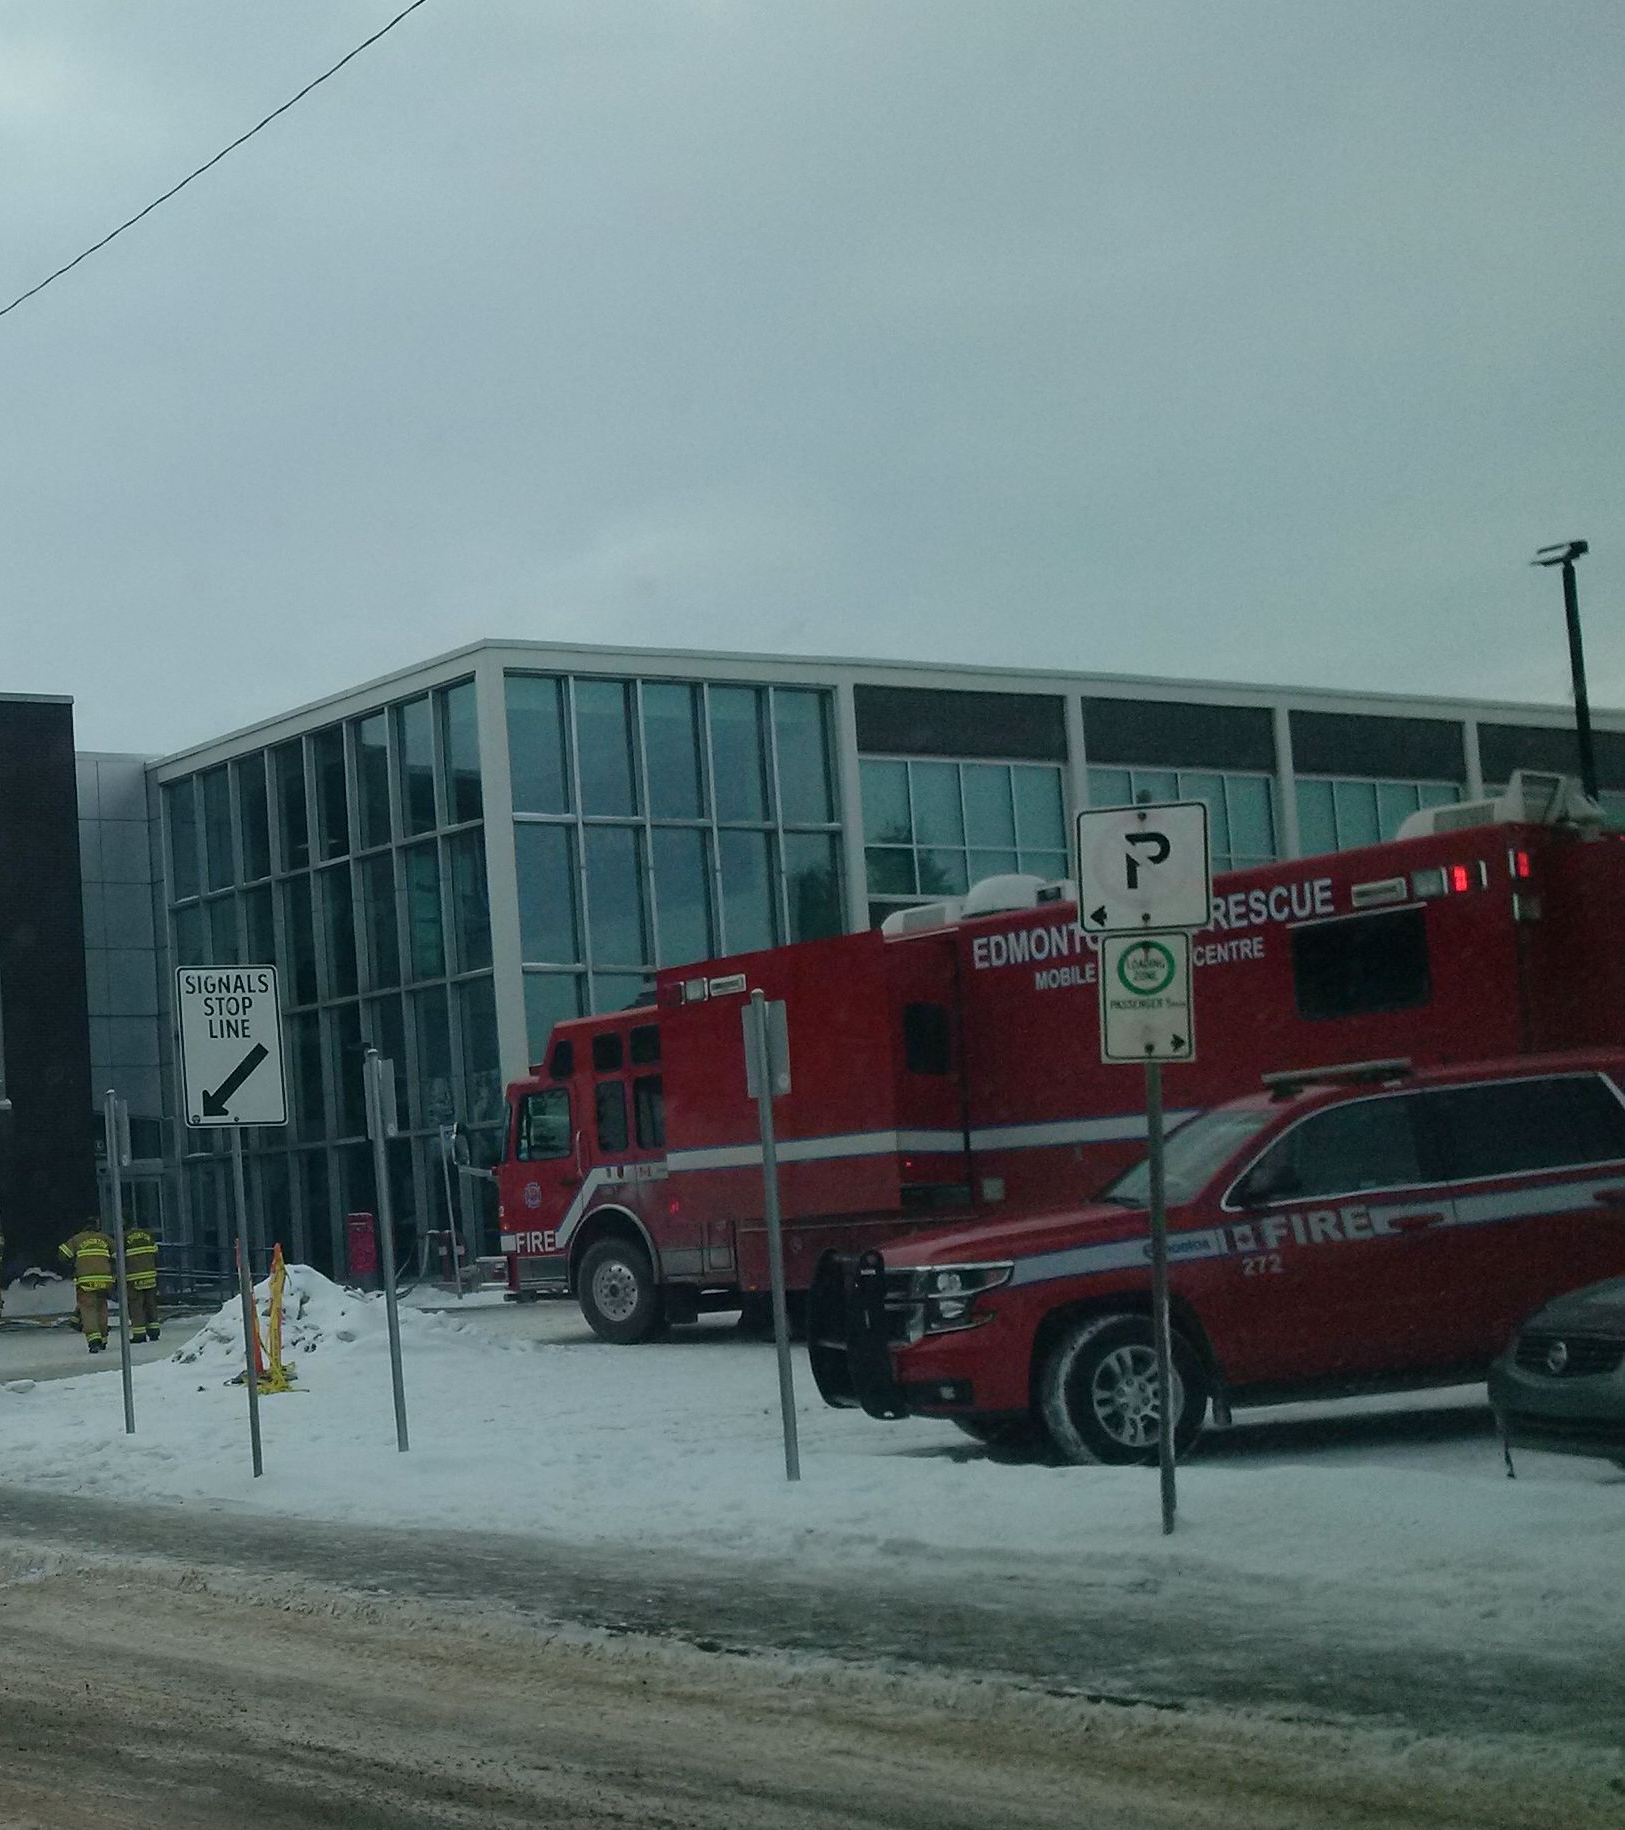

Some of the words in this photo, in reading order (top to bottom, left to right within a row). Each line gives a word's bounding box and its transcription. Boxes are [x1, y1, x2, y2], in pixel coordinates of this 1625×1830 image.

[973, 922, 1098, 970] EDMONT
[1209, 877, 1335, 931] RESCUE
[1035, 961, 1096, 991] MOBILE
[1193, 936, 1265, 967] CENTRE
[185, 973, 269, 994] SIGNALS
[203, 996, 253, 1016] STOP
[208, 1018, 251, 1038] LINE
[1262, 1205, 1375, 1249] FIRE
[516, 1230, 556, 1253] FIRE
